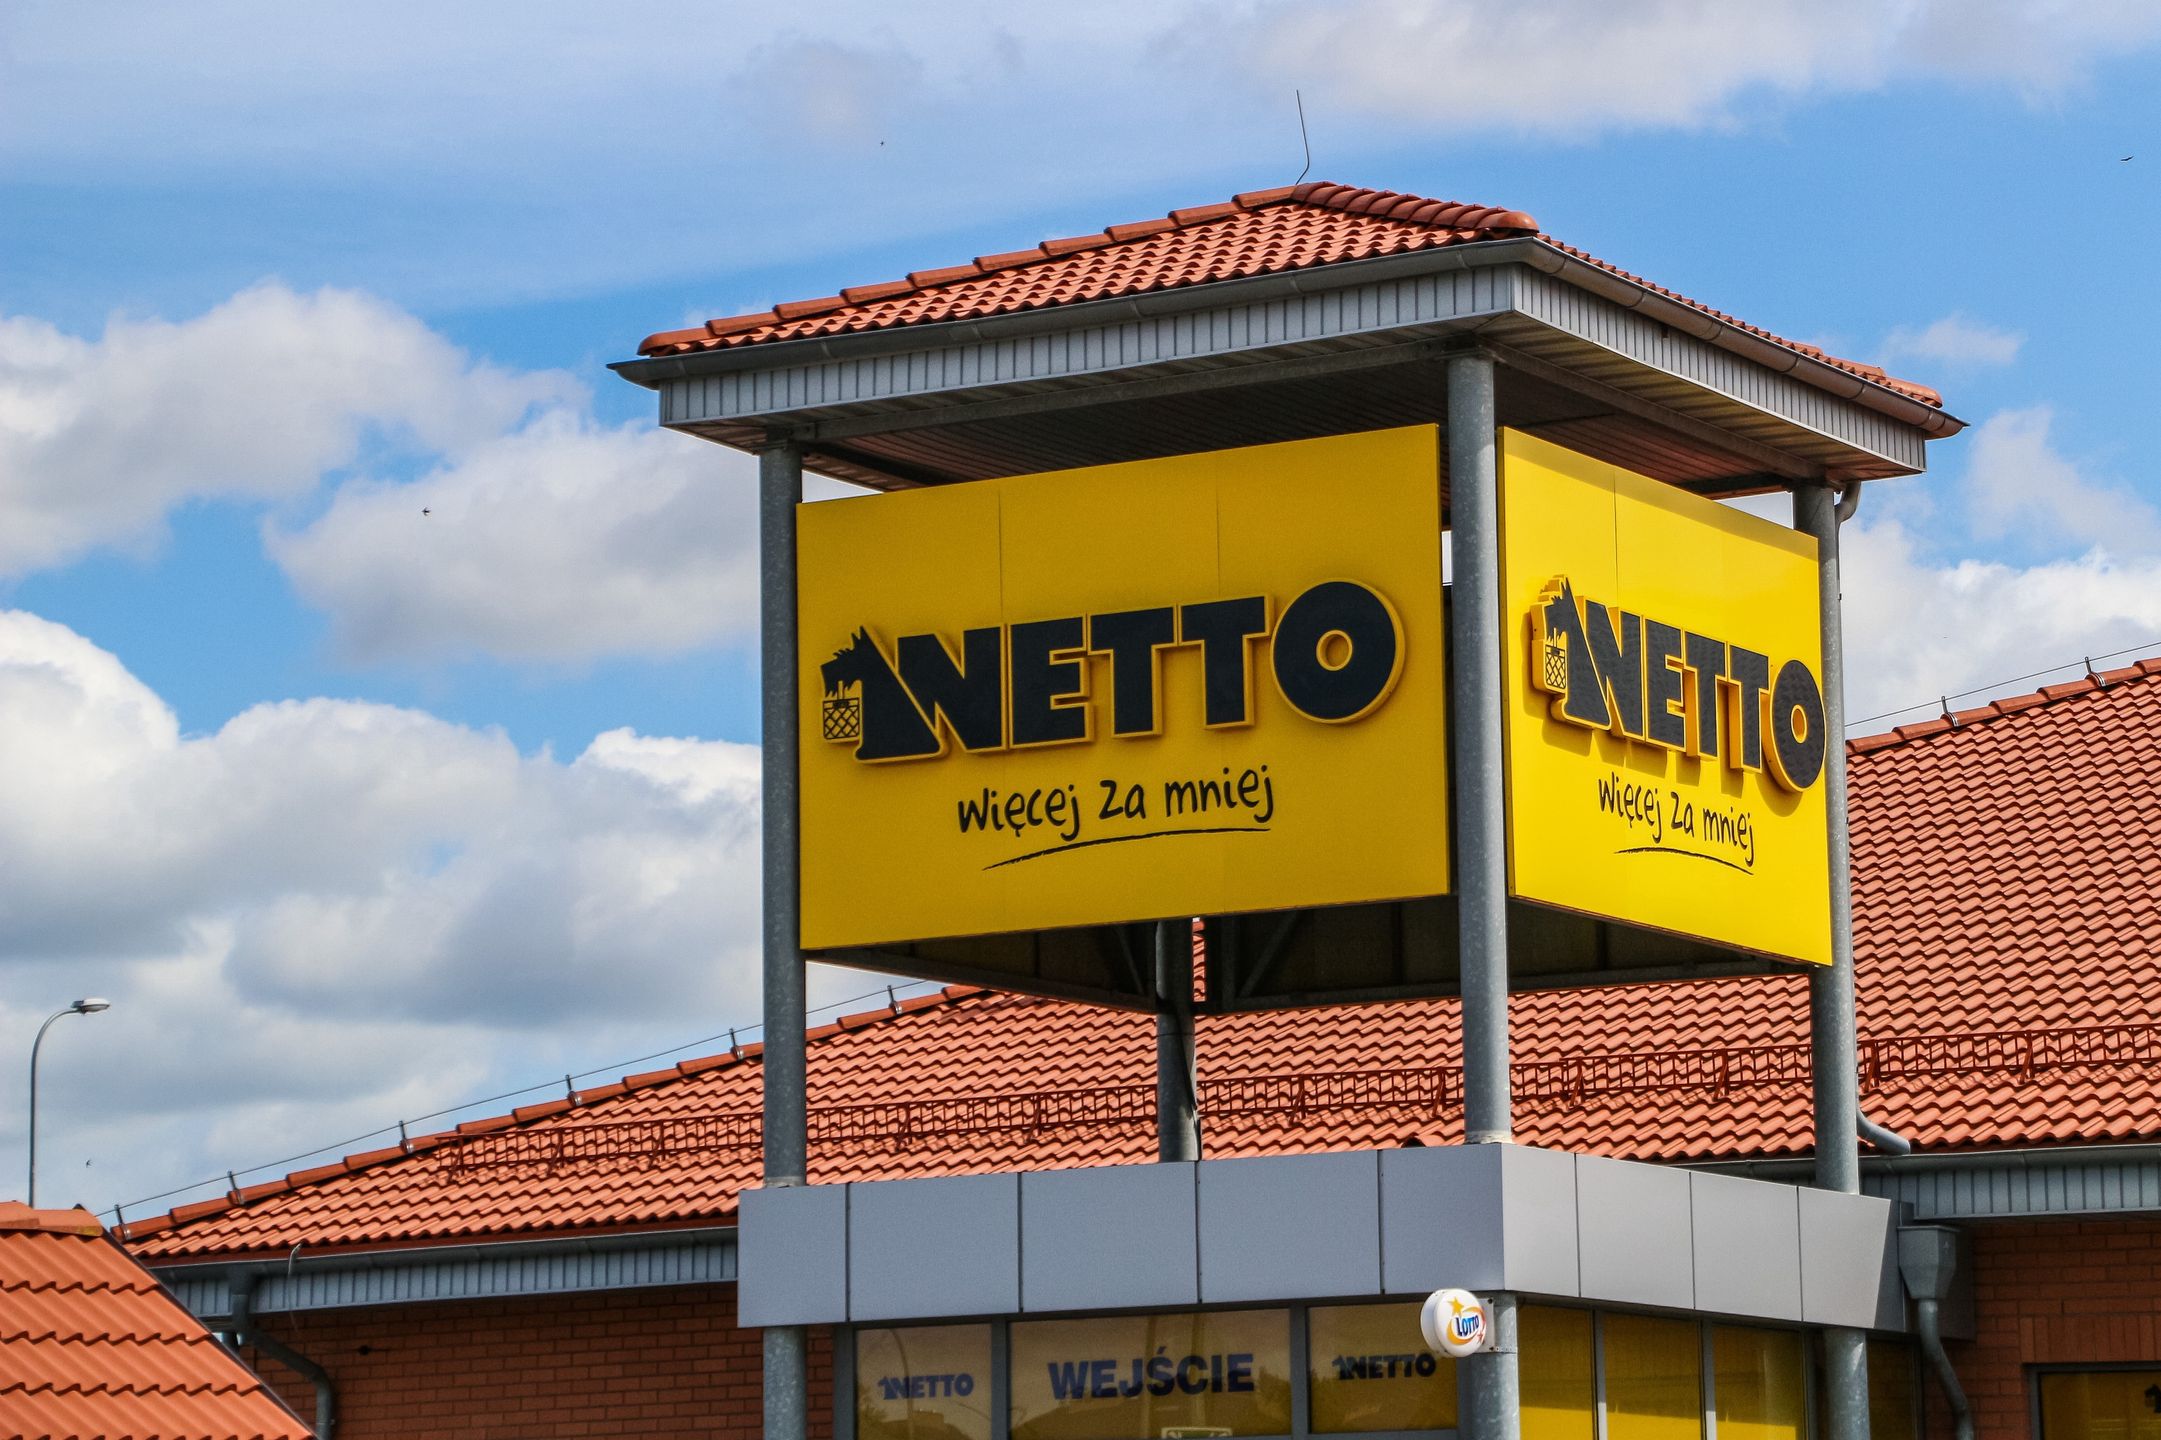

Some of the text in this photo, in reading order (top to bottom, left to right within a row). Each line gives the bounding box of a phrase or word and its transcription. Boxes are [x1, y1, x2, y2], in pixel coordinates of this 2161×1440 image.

[852, 580, 1402, 762] NETTO
[1562, 598, 1826, 791] NETTO
[1164, 764, 1274, 823] mniej
[1702, 806, 1754, 867] mniej
[1455, 1314, 1480, 1337] LOTTO
[883, 1373, 974, 1400] NETTO
[1047, 1346, 1255, 1400] WEJŚCIE
[1338, 1353, 1436, 1380] NETTO
